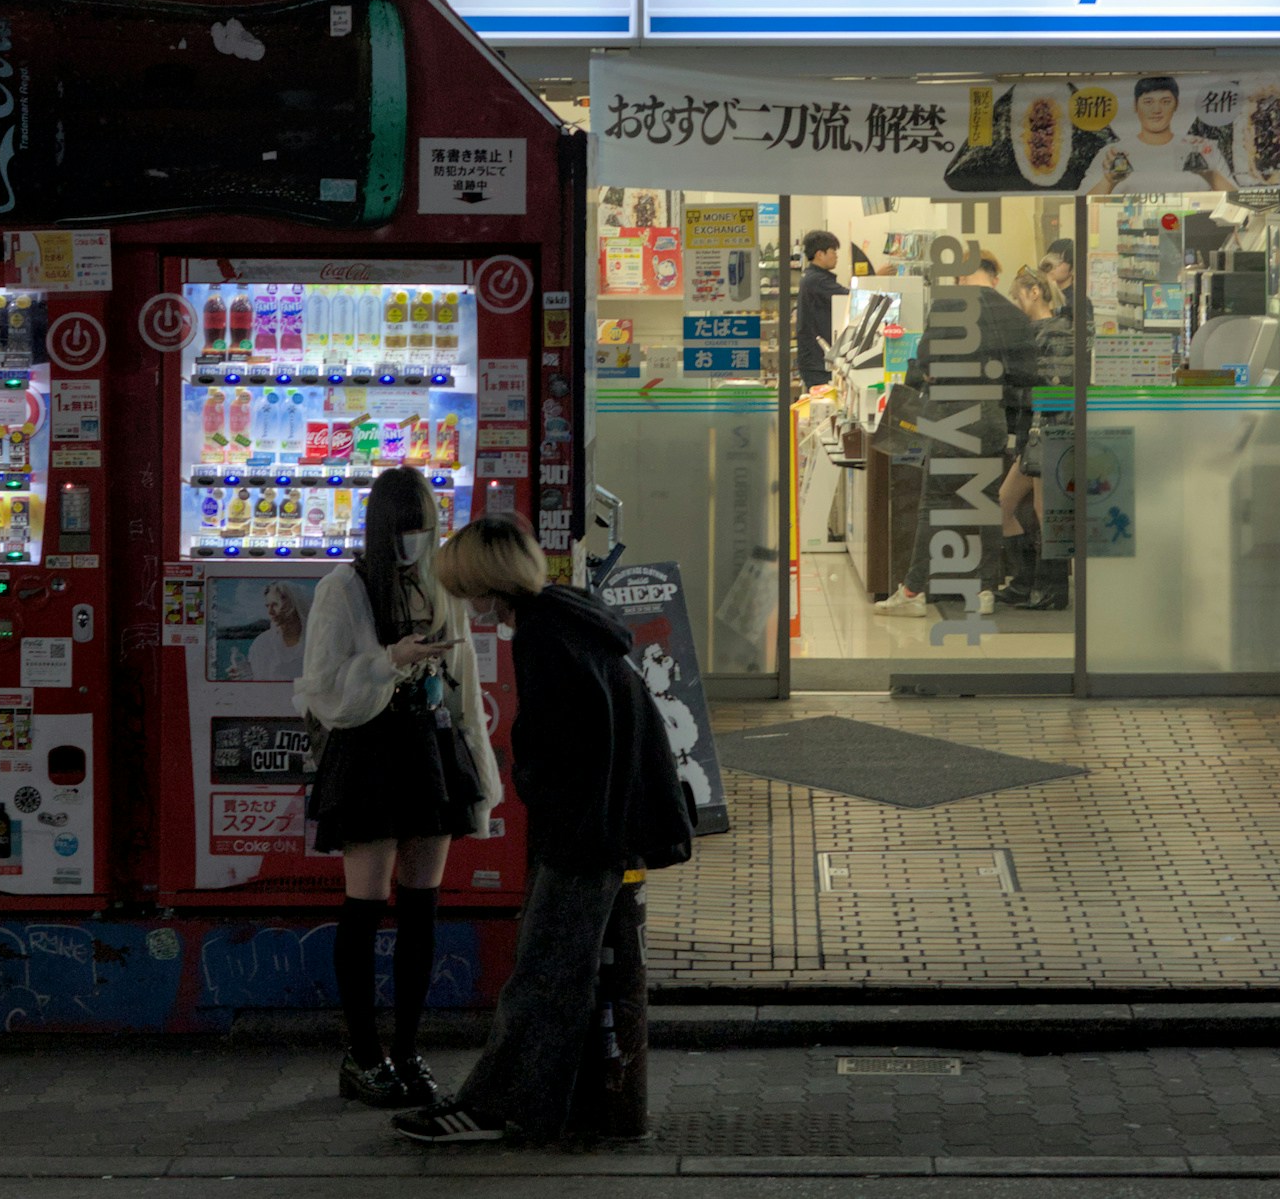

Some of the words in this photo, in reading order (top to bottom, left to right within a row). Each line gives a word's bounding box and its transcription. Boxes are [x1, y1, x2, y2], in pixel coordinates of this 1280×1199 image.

[1074, 95, 1111, 118] 新作
[1201, 90, 1239, 114] 名作
[605, 94, 955, 154] おむすび二刀流、解禁。
[432, 148, 513, 163] 落書き禁止！
[433, 165, 507, 177] 防犯カメラにて
[704, 212, 738, 222] MONEY
[694, 225, 748, 234] EXCHANGE
[695, 318, 748, 337] たばこ
[539, 464, 570, 484] CULT
[539, 510, 571, 529] CULT
[539, 530, 571, 550] CULT
[602, 583, 678, 606] SHEEP
[254, 751, 287, 770] CULT
[223, 799, 277, 813] 買うたび
[223, 812, 295, 832] スタンプ
[232, 839, 271, 853] Coke
